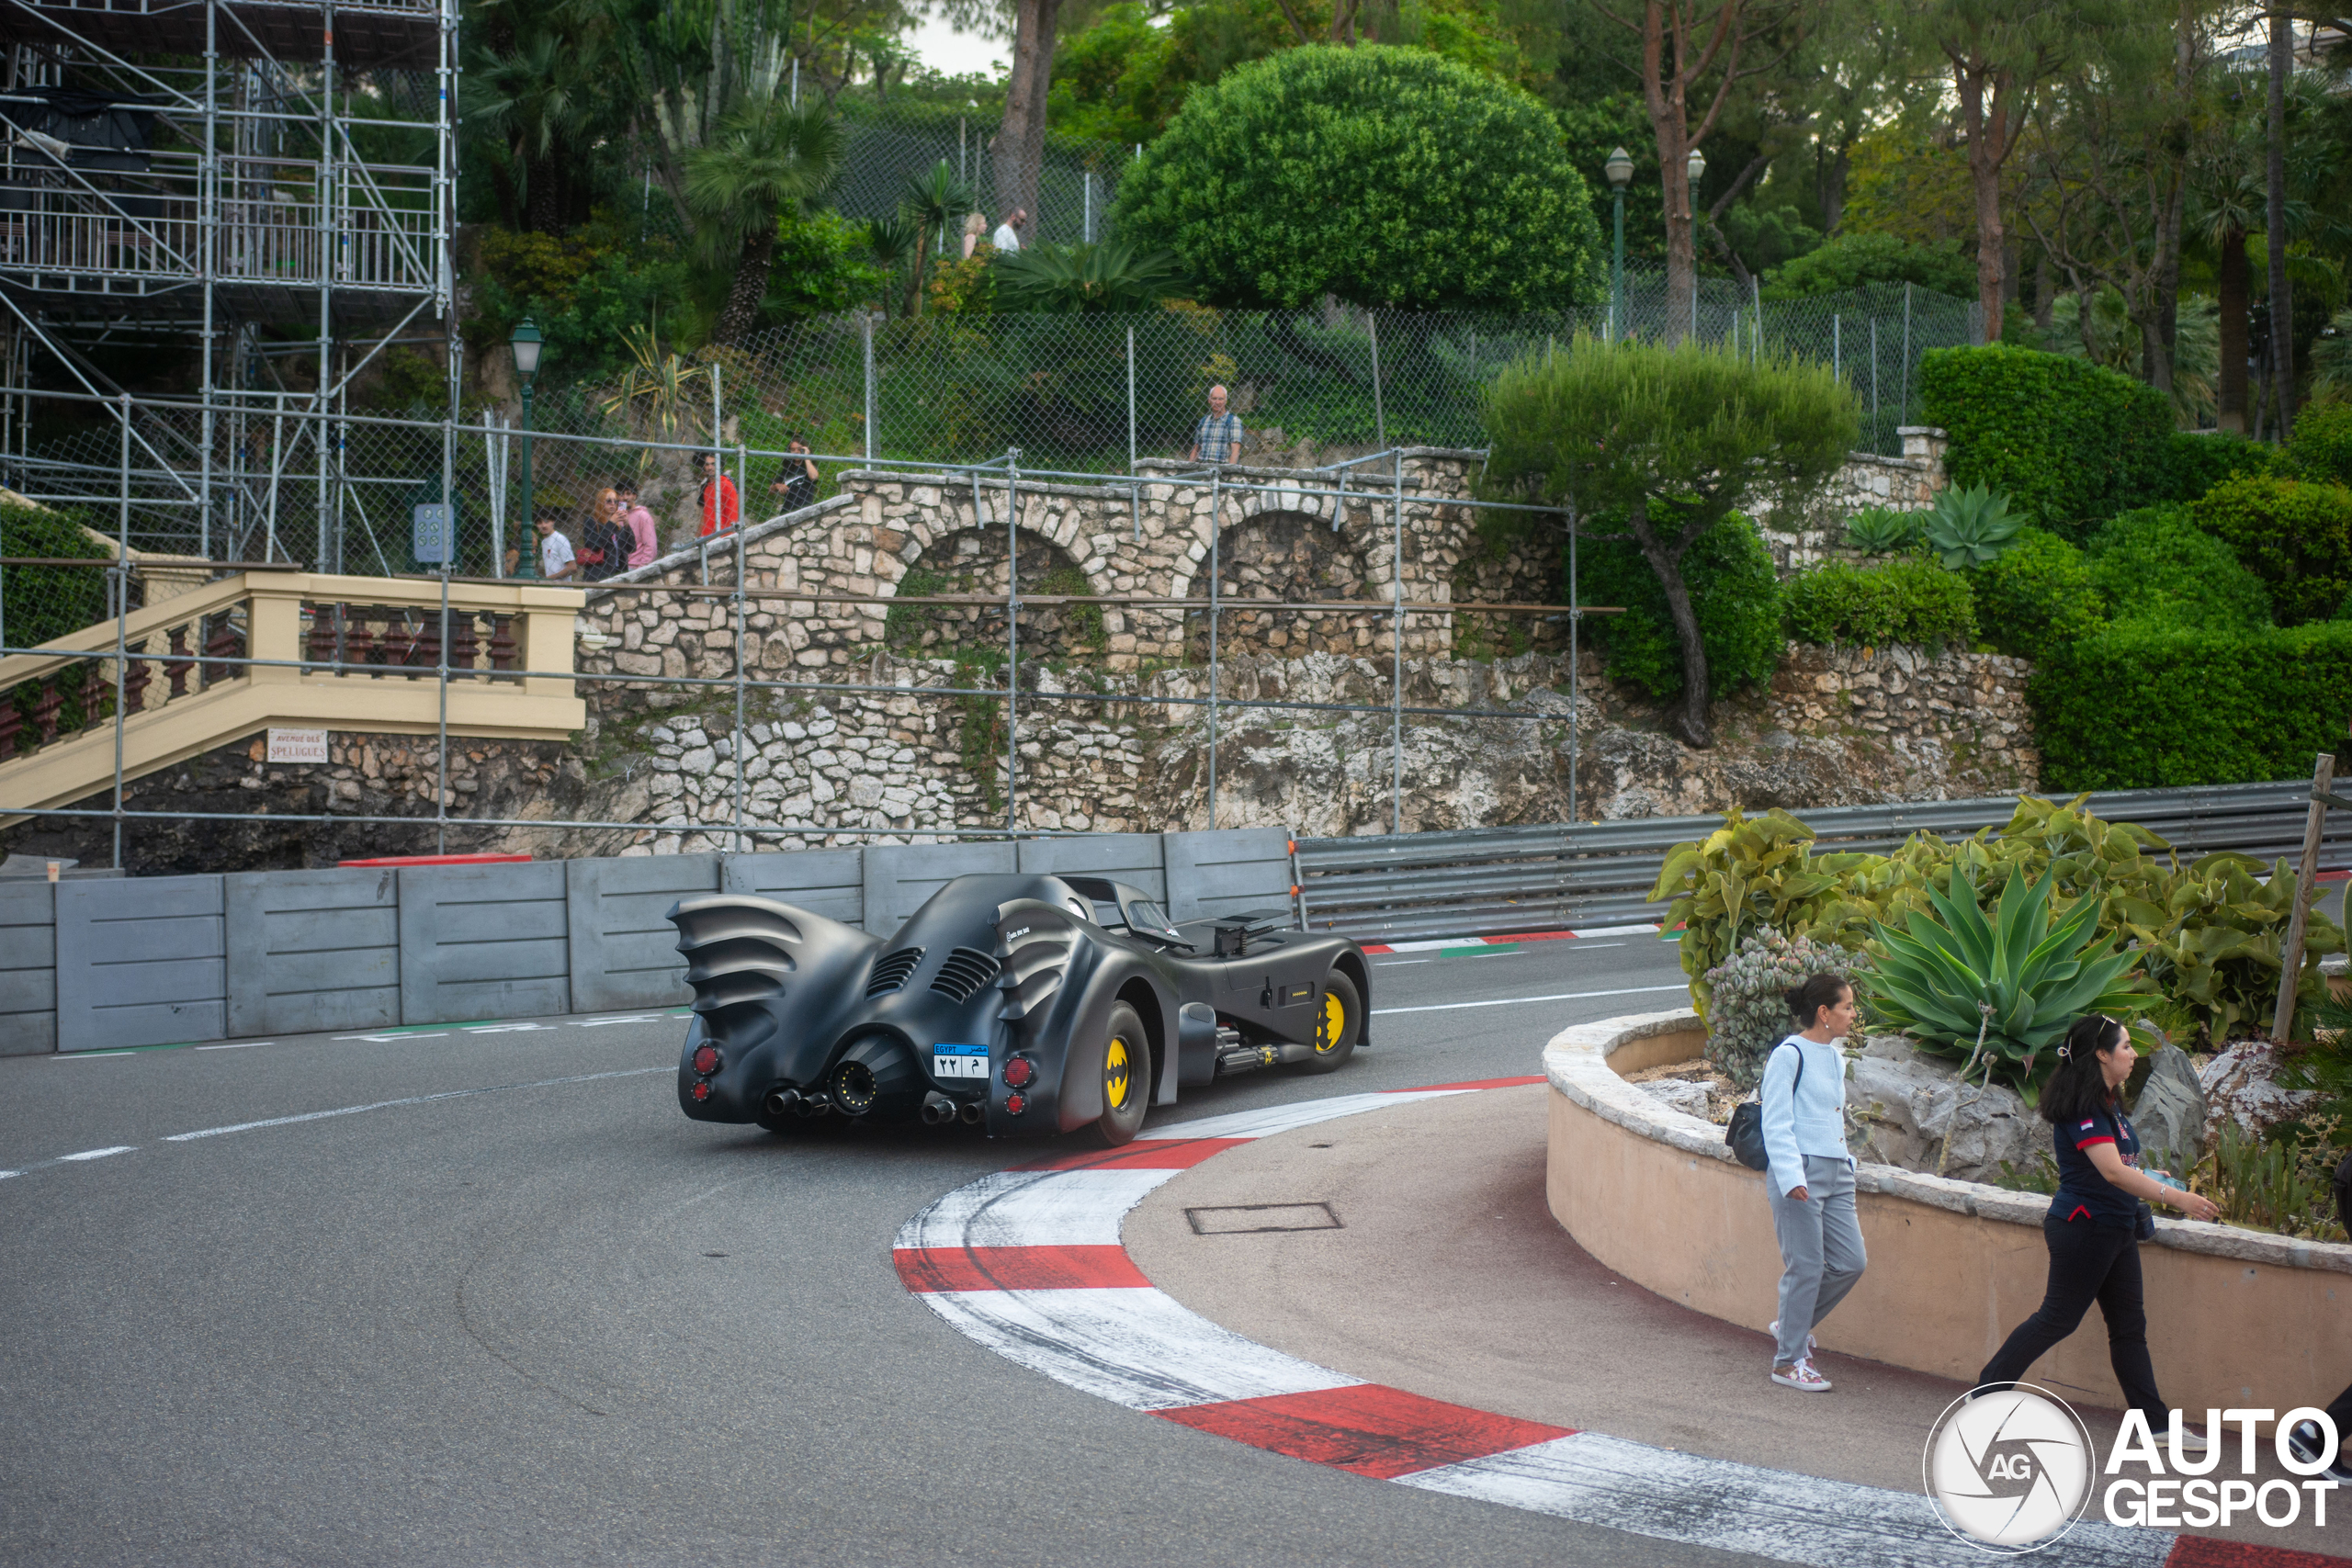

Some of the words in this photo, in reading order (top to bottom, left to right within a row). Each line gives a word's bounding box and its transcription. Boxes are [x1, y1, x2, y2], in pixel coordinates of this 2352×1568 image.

[271, 746, 325, 757] SPELUGUES
[935, 1045, 956, 1054] EGYPT
[971, 1058, 979, 1075] م
